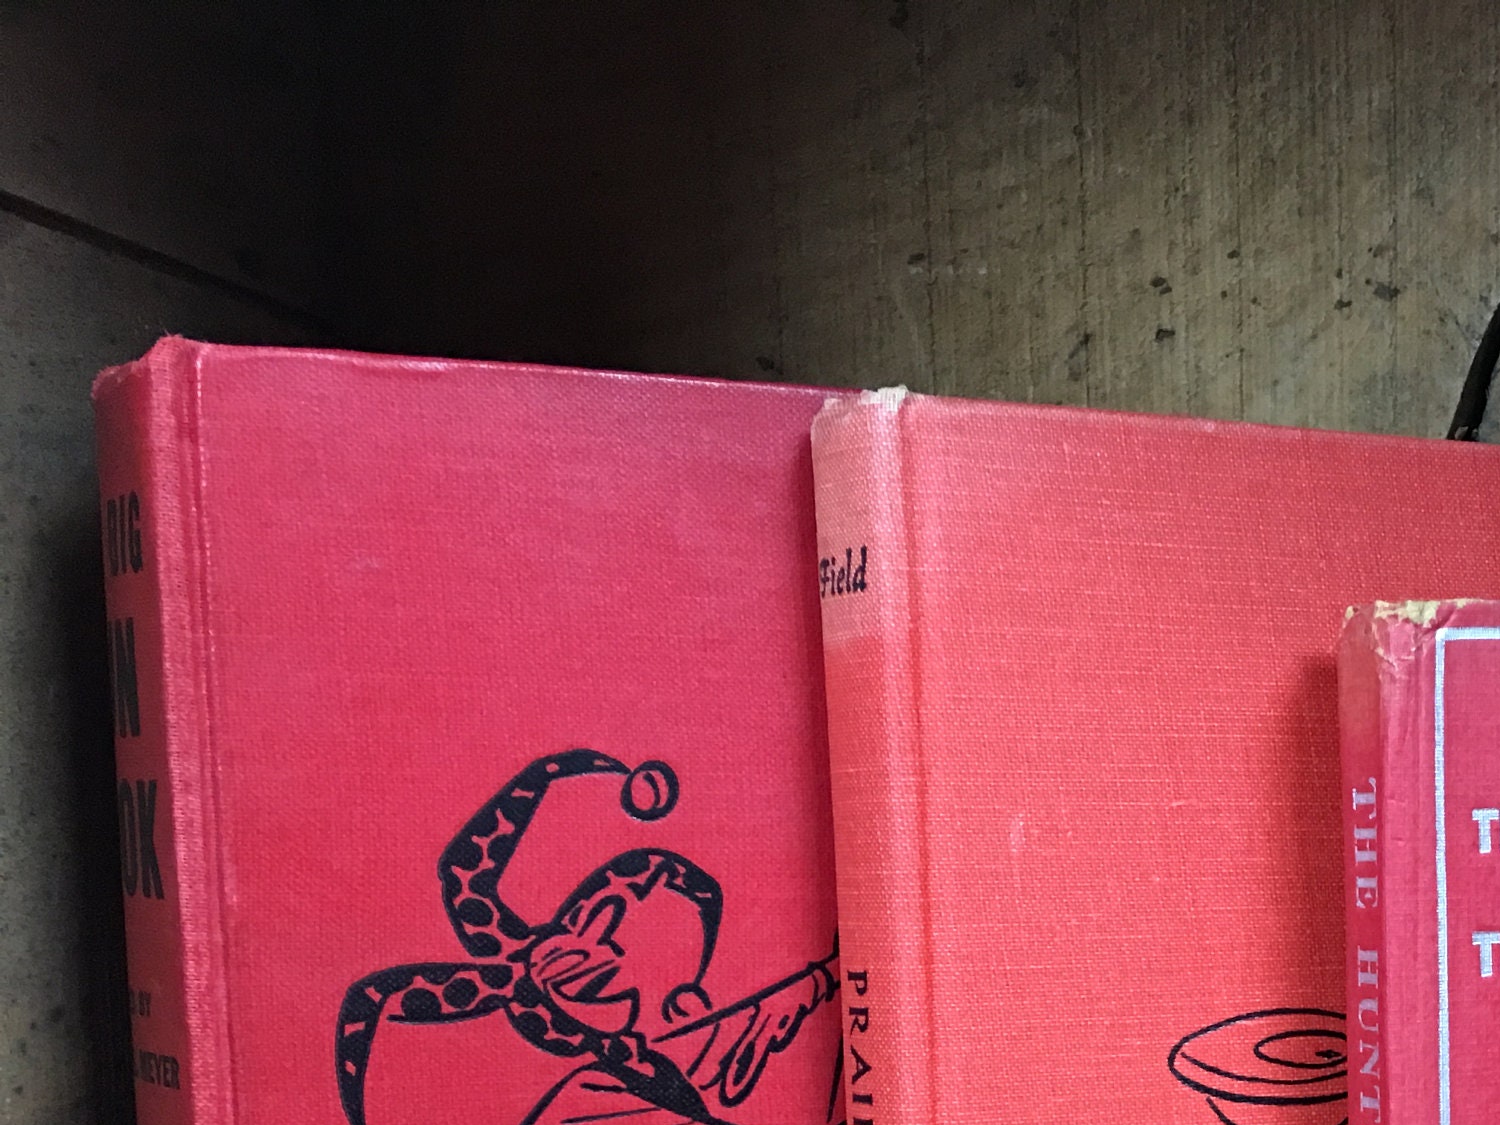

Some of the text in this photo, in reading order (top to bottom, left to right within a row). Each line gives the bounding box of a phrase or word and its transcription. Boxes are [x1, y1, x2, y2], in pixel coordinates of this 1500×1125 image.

[107, 490, 143, 576] BIG
[819, 544, 868, 599] Field
[1352, 777, 1378, 909] THE
